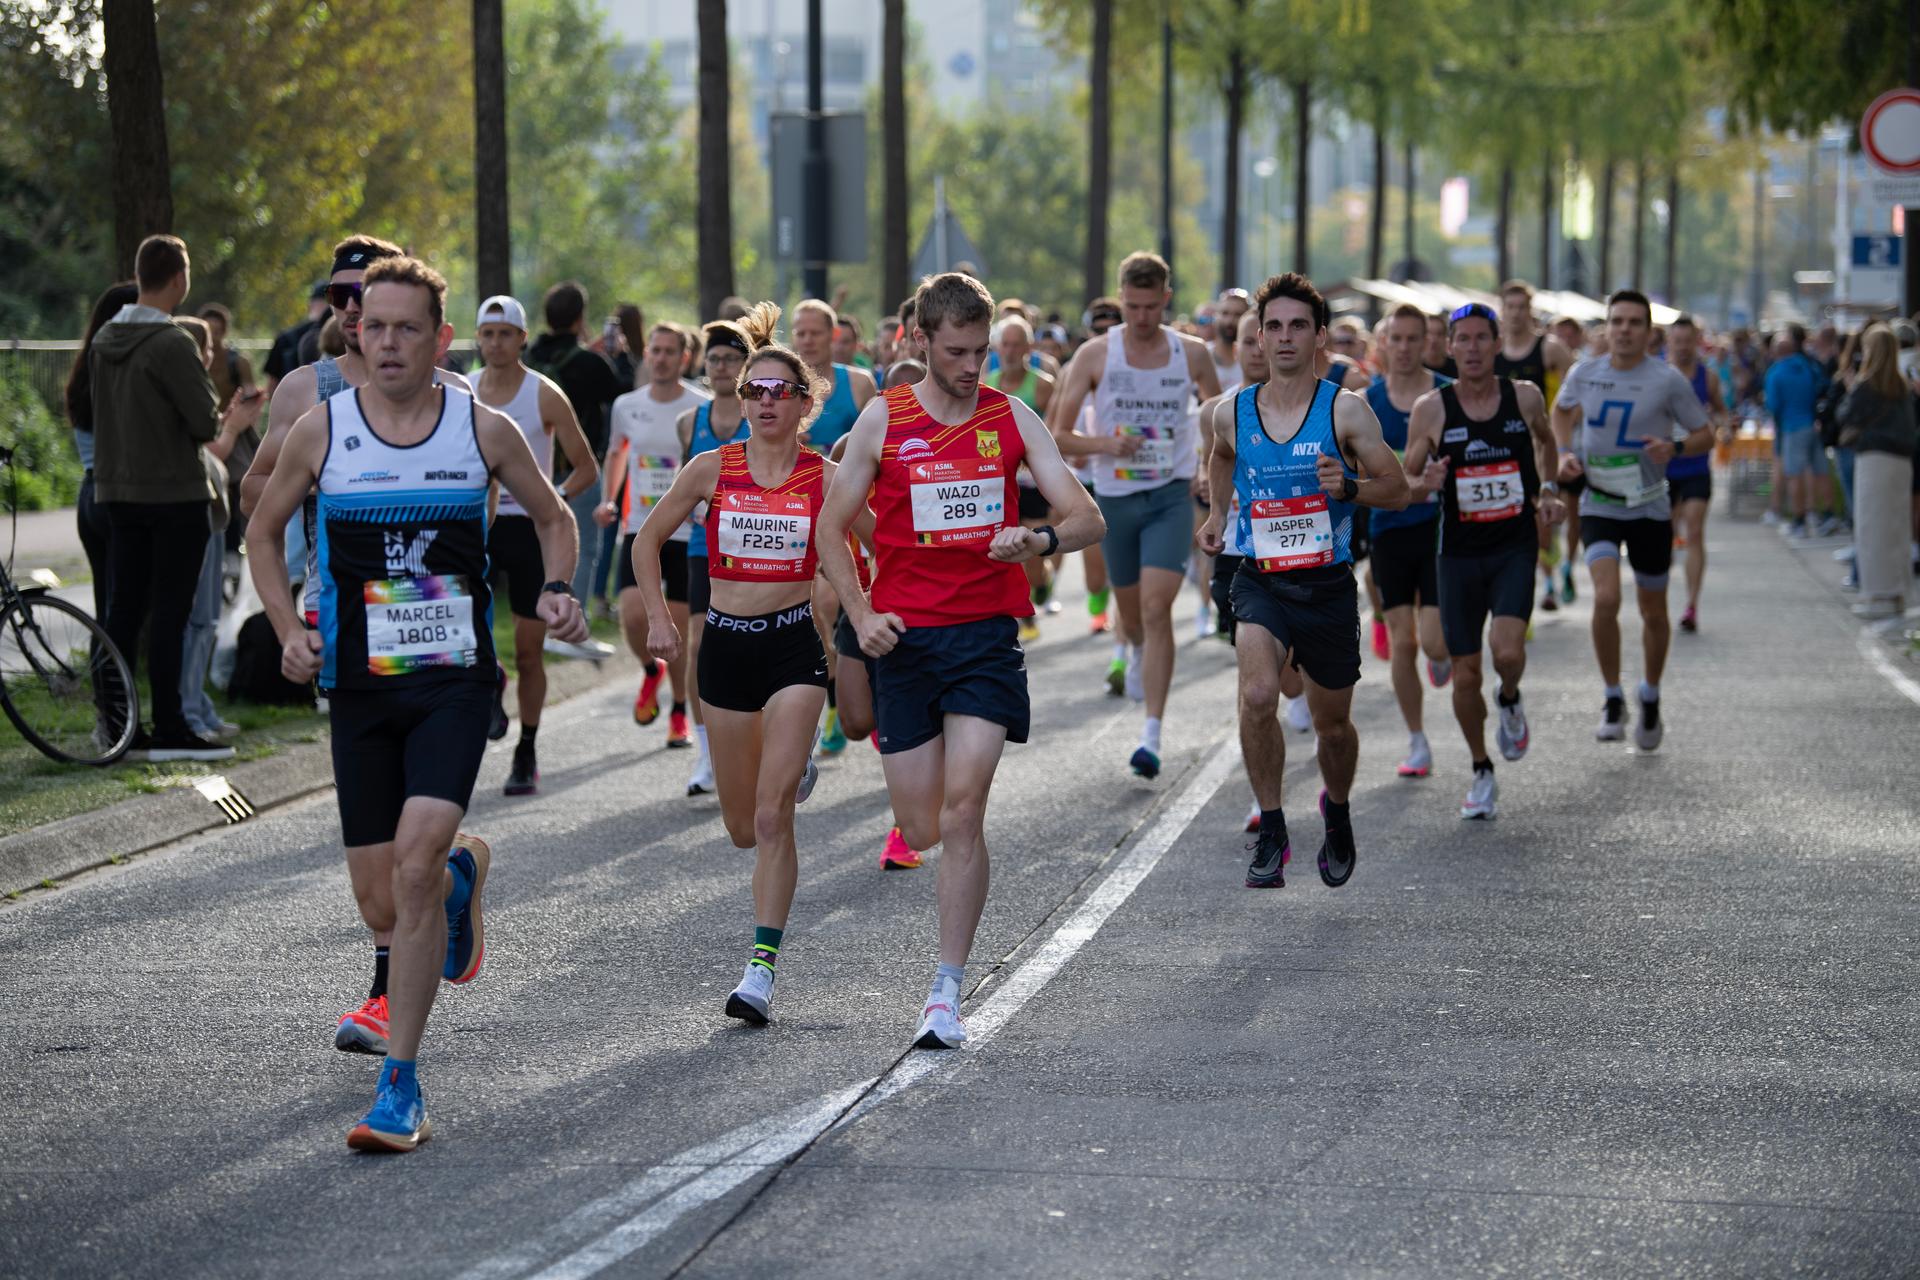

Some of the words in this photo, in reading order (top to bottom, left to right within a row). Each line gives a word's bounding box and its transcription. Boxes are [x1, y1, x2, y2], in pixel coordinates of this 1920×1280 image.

[1115, 398, 1179, 410] RUNNING
[1292, 442, 1322, 456] AVZK
[744, 494, 763, 502] ASML
[936, 485, 981, 501] WAZO
[1471, 481, 1510, 503] 313
[785, 502, 805, 510] ASML
[943, 502, 977, 520] 289
[1304, 501, 1322, 509] ASML
[731, 517, 798, 533] MAURINE
[1268, 518, 1315, 533] JASPER
[742, 533, 784, 550] F225
[942, 534, 952, 542] BK
[952, 530, 991, 541] MARATHON
[1280, 533, 1306, 548] 277
[742, 562, 753, 570] BK
[753, 563, 791, 571] MARATHON
[1278, 560, 1287, 568] BK
[1287, 556, 1321, 566] MARATHON
[386, 605, 455, 623] MARCEL
[718, 616, 768, 632] PRO
[397, 625, 448, 645] 1808
